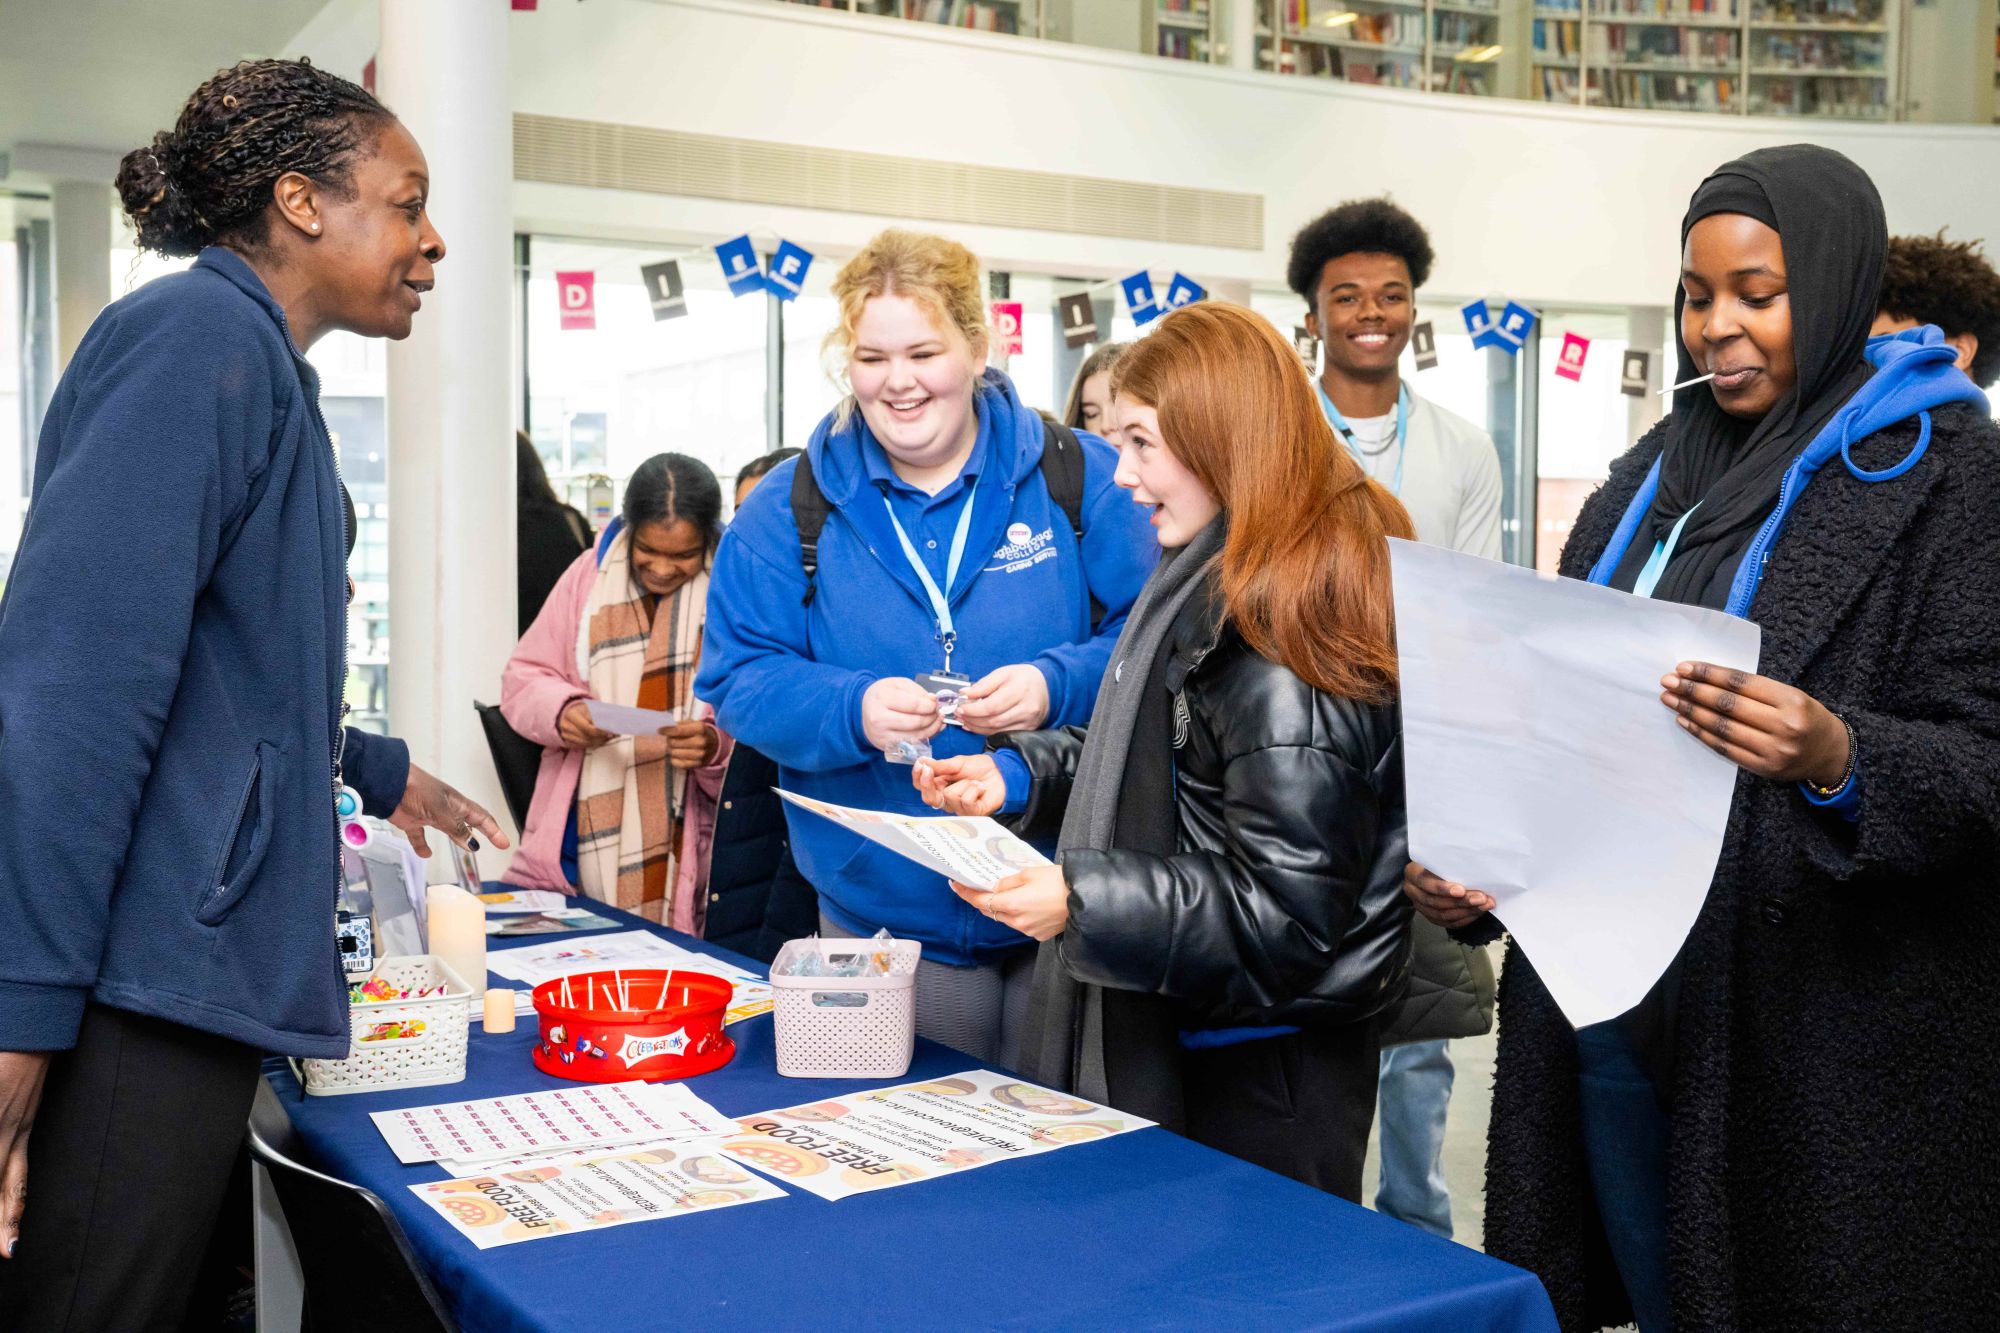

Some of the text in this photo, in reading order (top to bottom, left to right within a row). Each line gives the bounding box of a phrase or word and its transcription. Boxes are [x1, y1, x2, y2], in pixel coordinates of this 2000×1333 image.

[780, 255, 801, 276] F
[565, 284, 587, 307] D
[658, 274, 670, 298] I
[998, 314, 1017, 335] D
[1072, 304, 1082, 325] I
[1418, 332, 1428, 352] I
[1564, 342, 1583, 363] R
[793, 1125, 828, 1136] need
[752, 1122, 895, 1175] FREE FOOD
[838, 1141, 874, 1155] those
[870, 1154, 894, 1162] for
[475, 1182, 550, 1228] FREE FOOD
